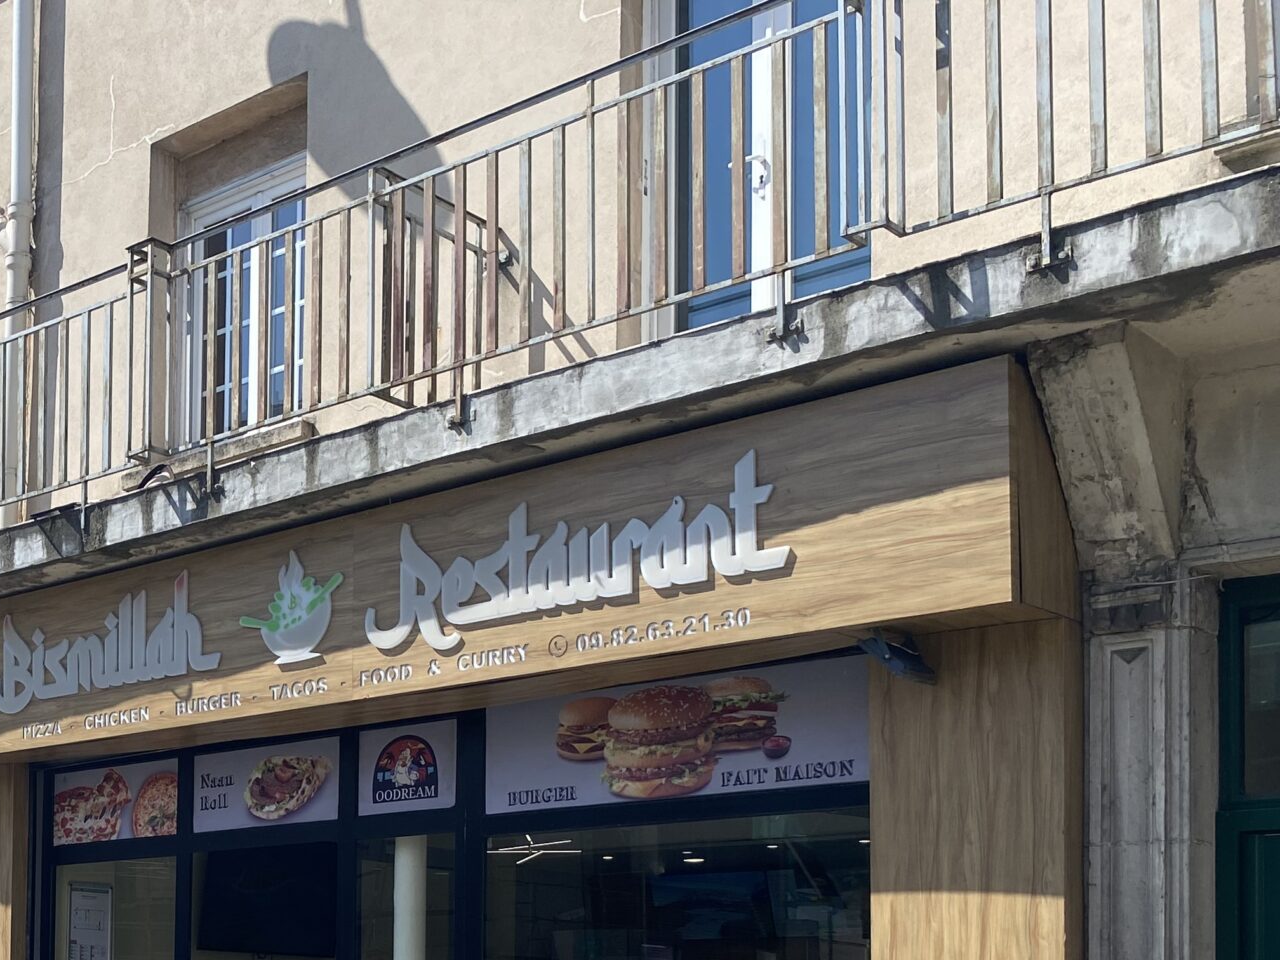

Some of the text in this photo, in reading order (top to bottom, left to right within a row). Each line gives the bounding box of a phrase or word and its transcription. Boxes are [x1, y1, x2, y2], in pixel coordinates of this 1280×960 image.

[364, 448, 790, 650] Restaurant
[575, 608, 751, 653] 09.82.63.21.30
[23, 644, 528, 739] PIZZA CHICKEN BURGER TACOS FOOD & CURRY
[200, 772, 235, 789] Naan
[720, 759, 855, 787] FAIT MAISON
[200, 795, 229, 812] Roll
[375, 784, 435, 802] OODREAM
[507, 785, 577, 807] BURGER
